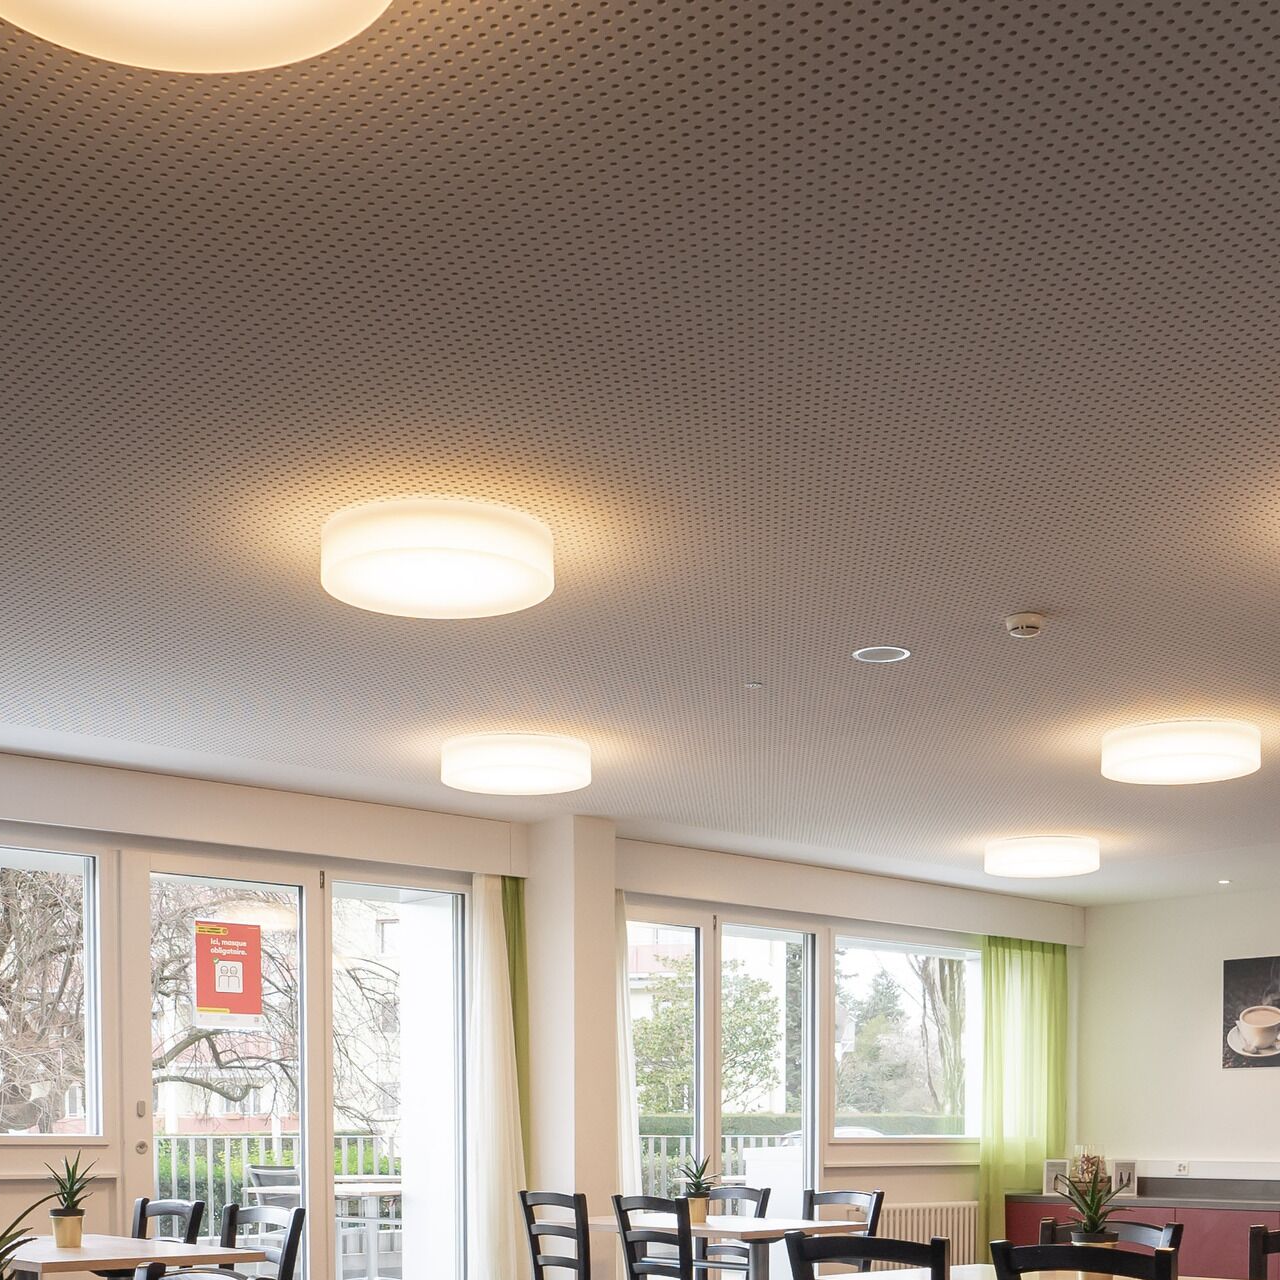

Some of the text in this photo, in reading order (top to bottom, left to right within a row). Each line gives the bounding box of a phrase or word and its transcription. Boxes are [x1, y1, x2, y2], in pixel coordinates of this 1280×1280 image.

[210, 937, 247, 948] Ici, masque
[210, 947, 247, 956] obligatoire.
